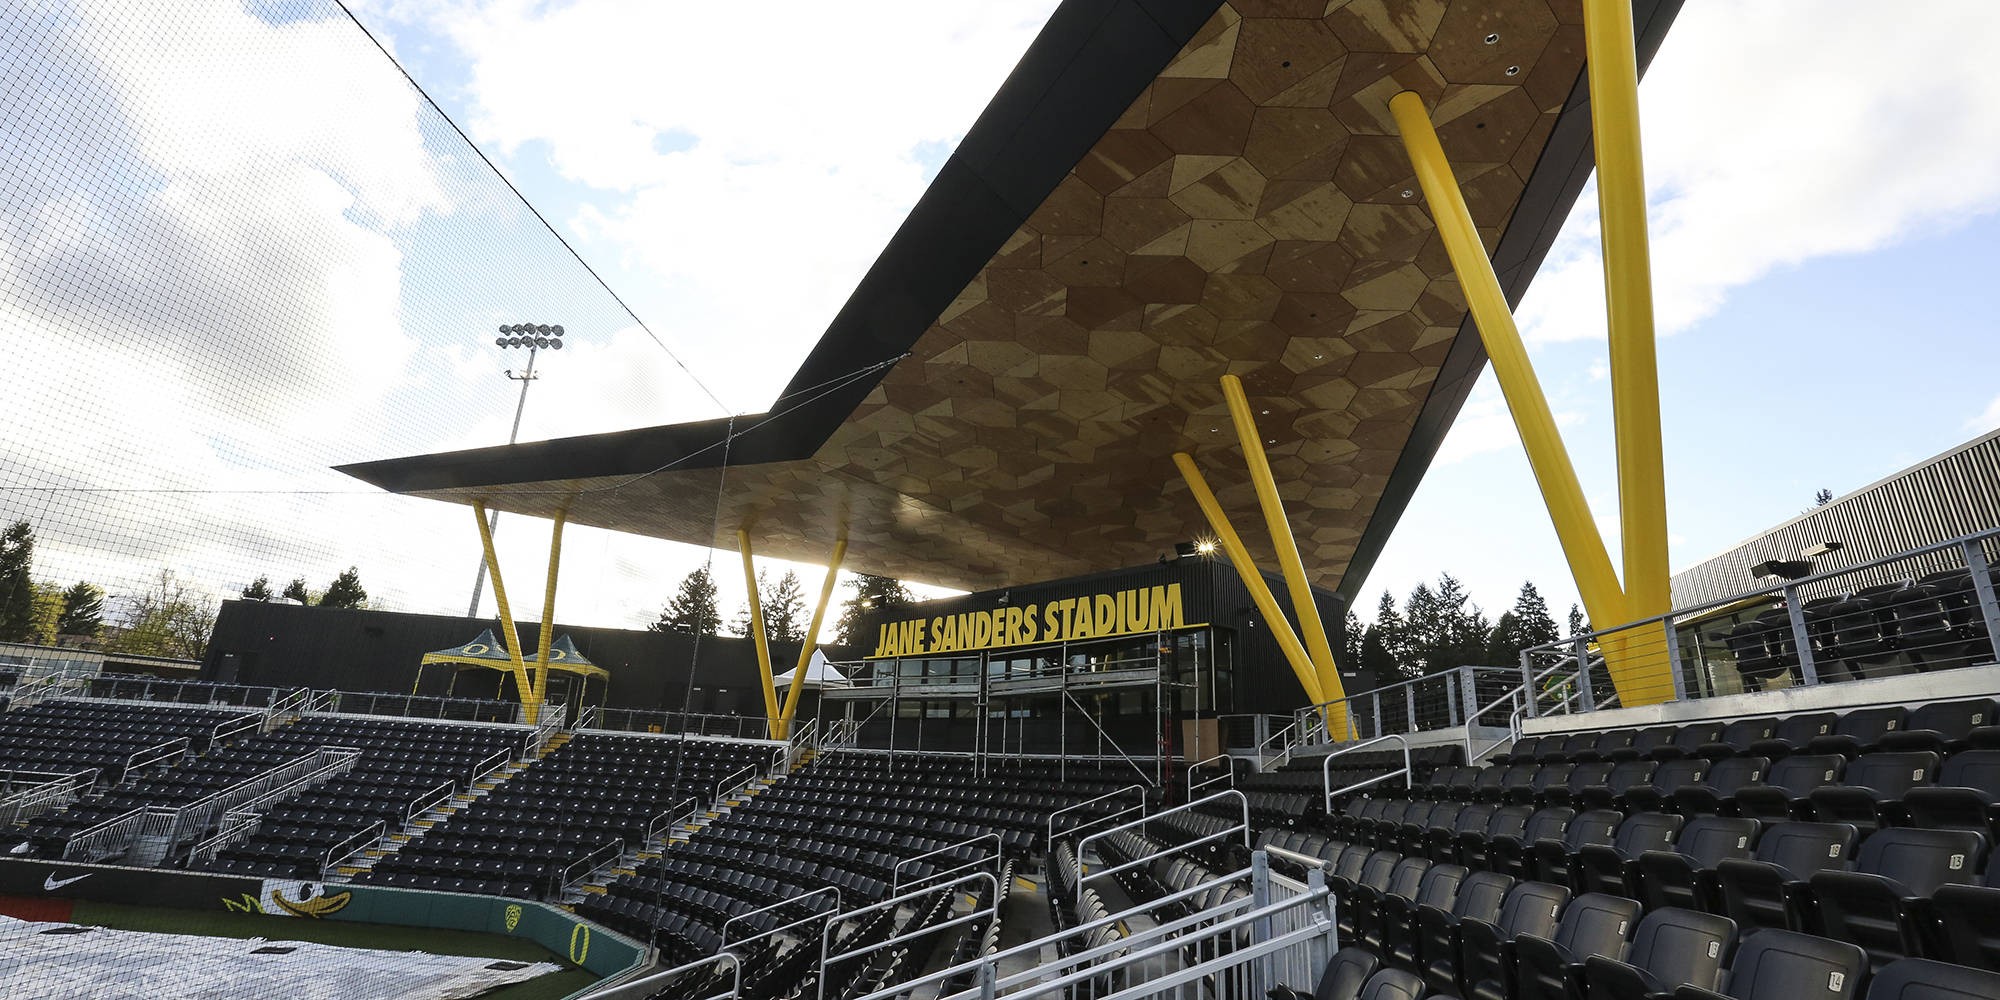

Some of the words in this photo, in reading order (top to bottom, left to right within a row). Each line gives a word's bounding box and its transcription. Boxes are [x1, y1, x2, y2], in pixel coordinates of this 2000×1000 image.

[875, 618, 926, 657] JANE
[930, 604, 1038, 652] SANDERS
[1044, 583, 1184, 642] STADIUM
[1951, 856, 1962, 868] 13
[1831, 973, 1842, 989] 14
